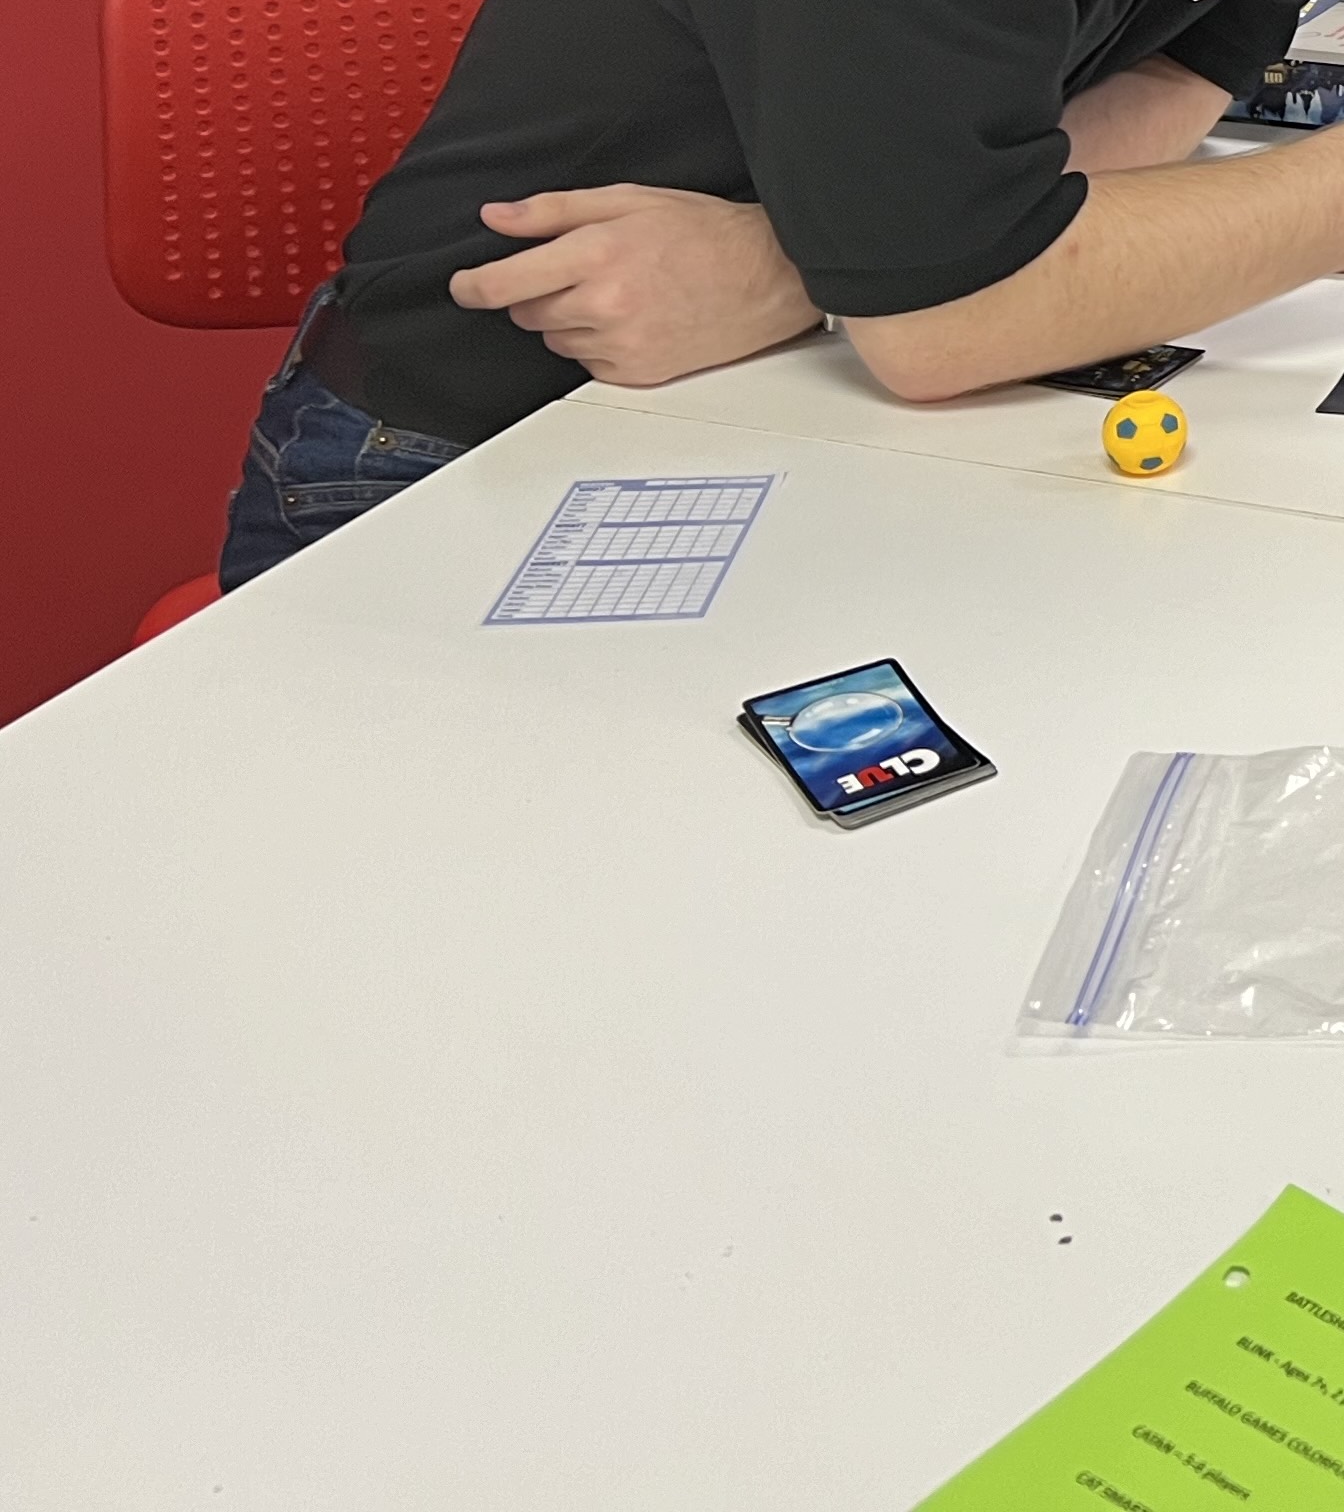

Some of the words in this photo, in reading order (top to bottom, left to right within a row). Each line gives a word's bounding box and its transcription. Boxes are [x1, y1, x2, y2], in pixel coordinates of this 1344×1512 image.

[836, 748, 940, 795] CLUE
[1235, 1334, 1275, 1364] BLINK
[1279, 1360, 1311, 1383] Ages
[1330, 1387, 1344, 1400] 2
[1240, 1411, 1289, 1444] GAMES
[1075, 1469, 1103, 1492] CAT
[1131, 1424, 1176, 1455] CATAN
[1203, 1467, 1251, 1503] players
